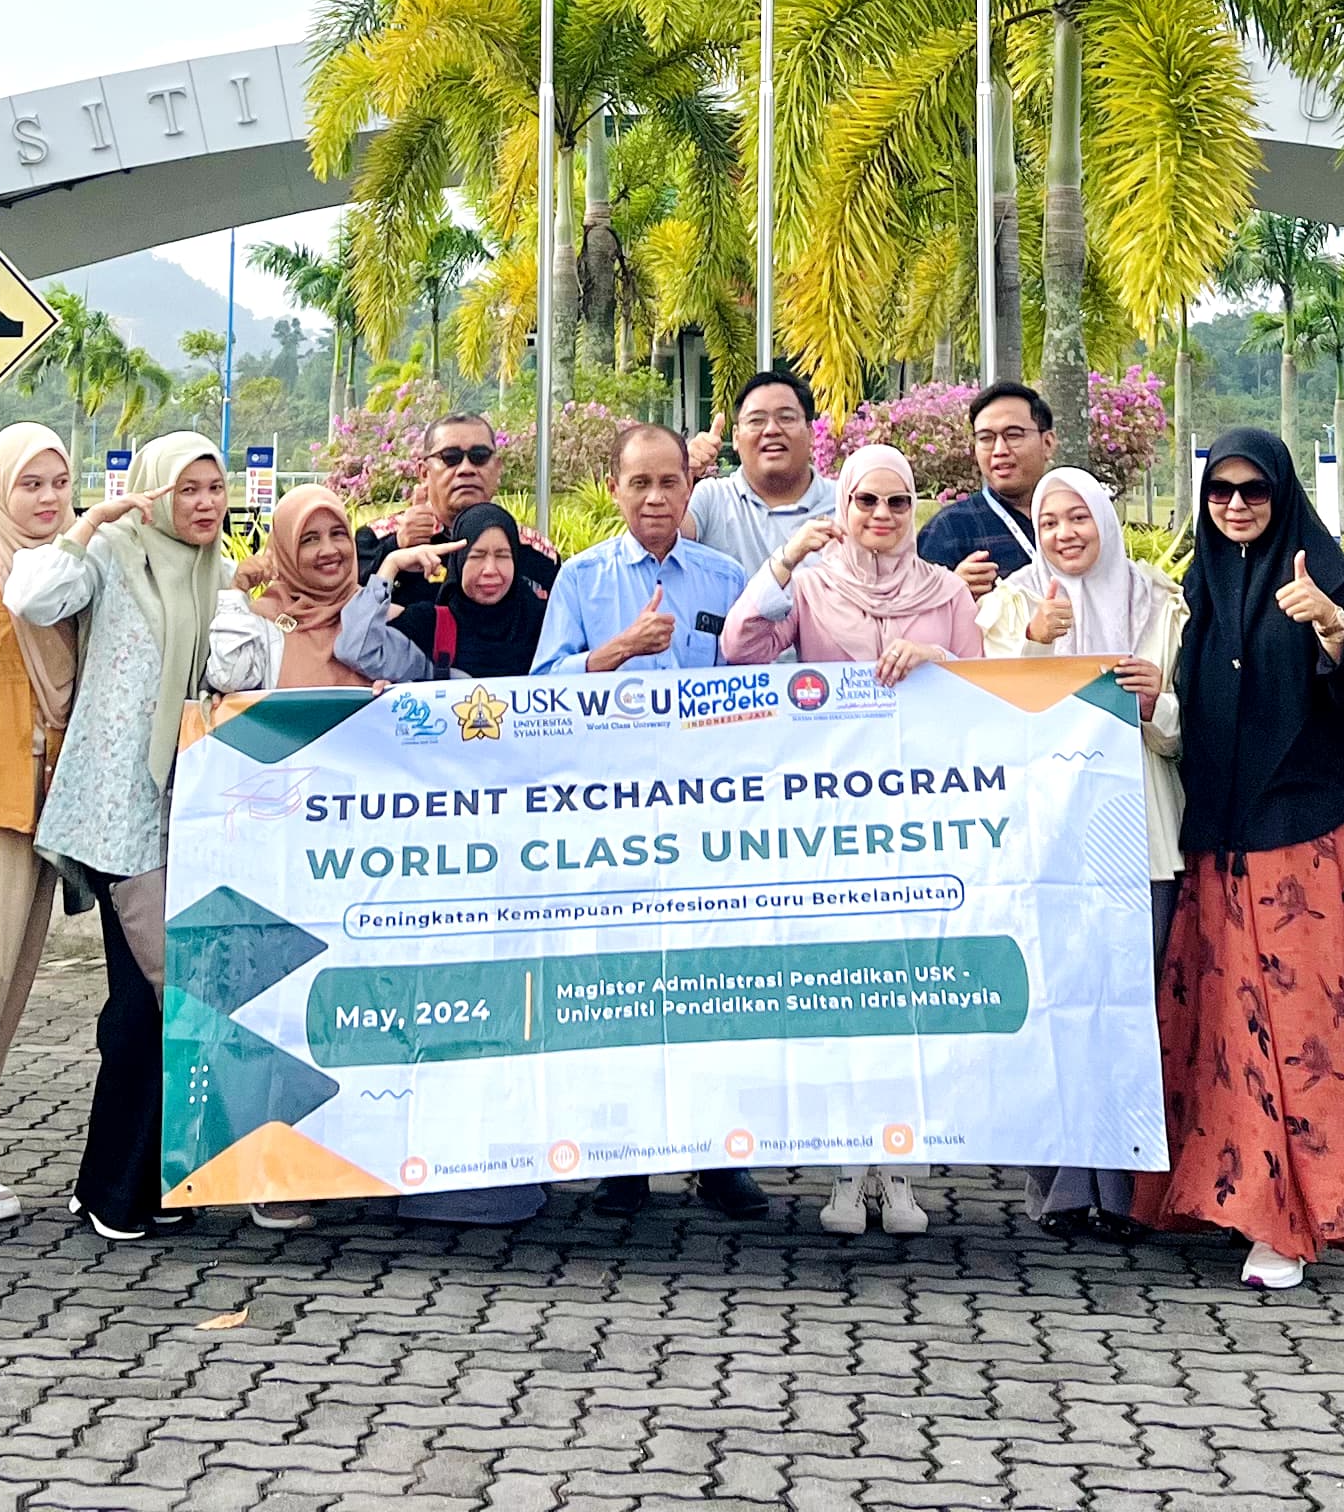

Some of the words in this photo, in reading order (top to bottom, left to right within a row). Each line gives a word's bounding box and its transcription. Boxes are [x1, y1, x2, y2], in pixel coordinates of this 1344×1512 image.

[510, 687, 573, 714] USK
[677, 671, 771, 701] Kampus
[836, 687, 871, 701] SULTAN
[678, 689, 779, 719] Merdeka
[687, 714, 743, 728] INDONESIA
[748, 710, 773, 721] JAYA
[513, 718, 573, 729] UNIVERSITAS
[542, 727, 574, 737] KUALA
[586, 722, 609, 731] World
[611, 721, 631, 730] Class
[633, 720, 671, 730] University
[305, 787, 508, 822] STUDENT
[525, 774, 765, 814] EXCHANGE
[784, 765, 1007, 801] PROGRAM
[306, 842, 499, 880] WORLD
[520, 833, 681, 872] CLASS
[701, 816, 1011, 863] UNIVERSITY
[359, 909, 489, 929] Peningkatan
[497, 903, 624, 922] Kemampuan
[632, 895, 748, 915] Profesional
[755, 894, 805, 908] Guru
[812, 886, 959, 906] Berkelanjutan
[557, 979, 646, 1001] Magister
[652, 969, 784, 993] Administrasi
[790, 968, 908, 987] Pendidikan
[914, 966, 956, 983] USK
[335, 1005, 406, 1032] May,
[415, 998, 491, 1025] 2024
[556, 1000, 656, 1024] Universiti
[662, 996, 780, 1016] Pendidikan
[786, 992, 854, 1011] Sultan
[860, 990, 907, 1009] Idris
[911, 988, 1002, 1009] Malaysia
[434, 1159, 508, 1176] Pascasarjana
[510, 1156, 535, 1169] USK
